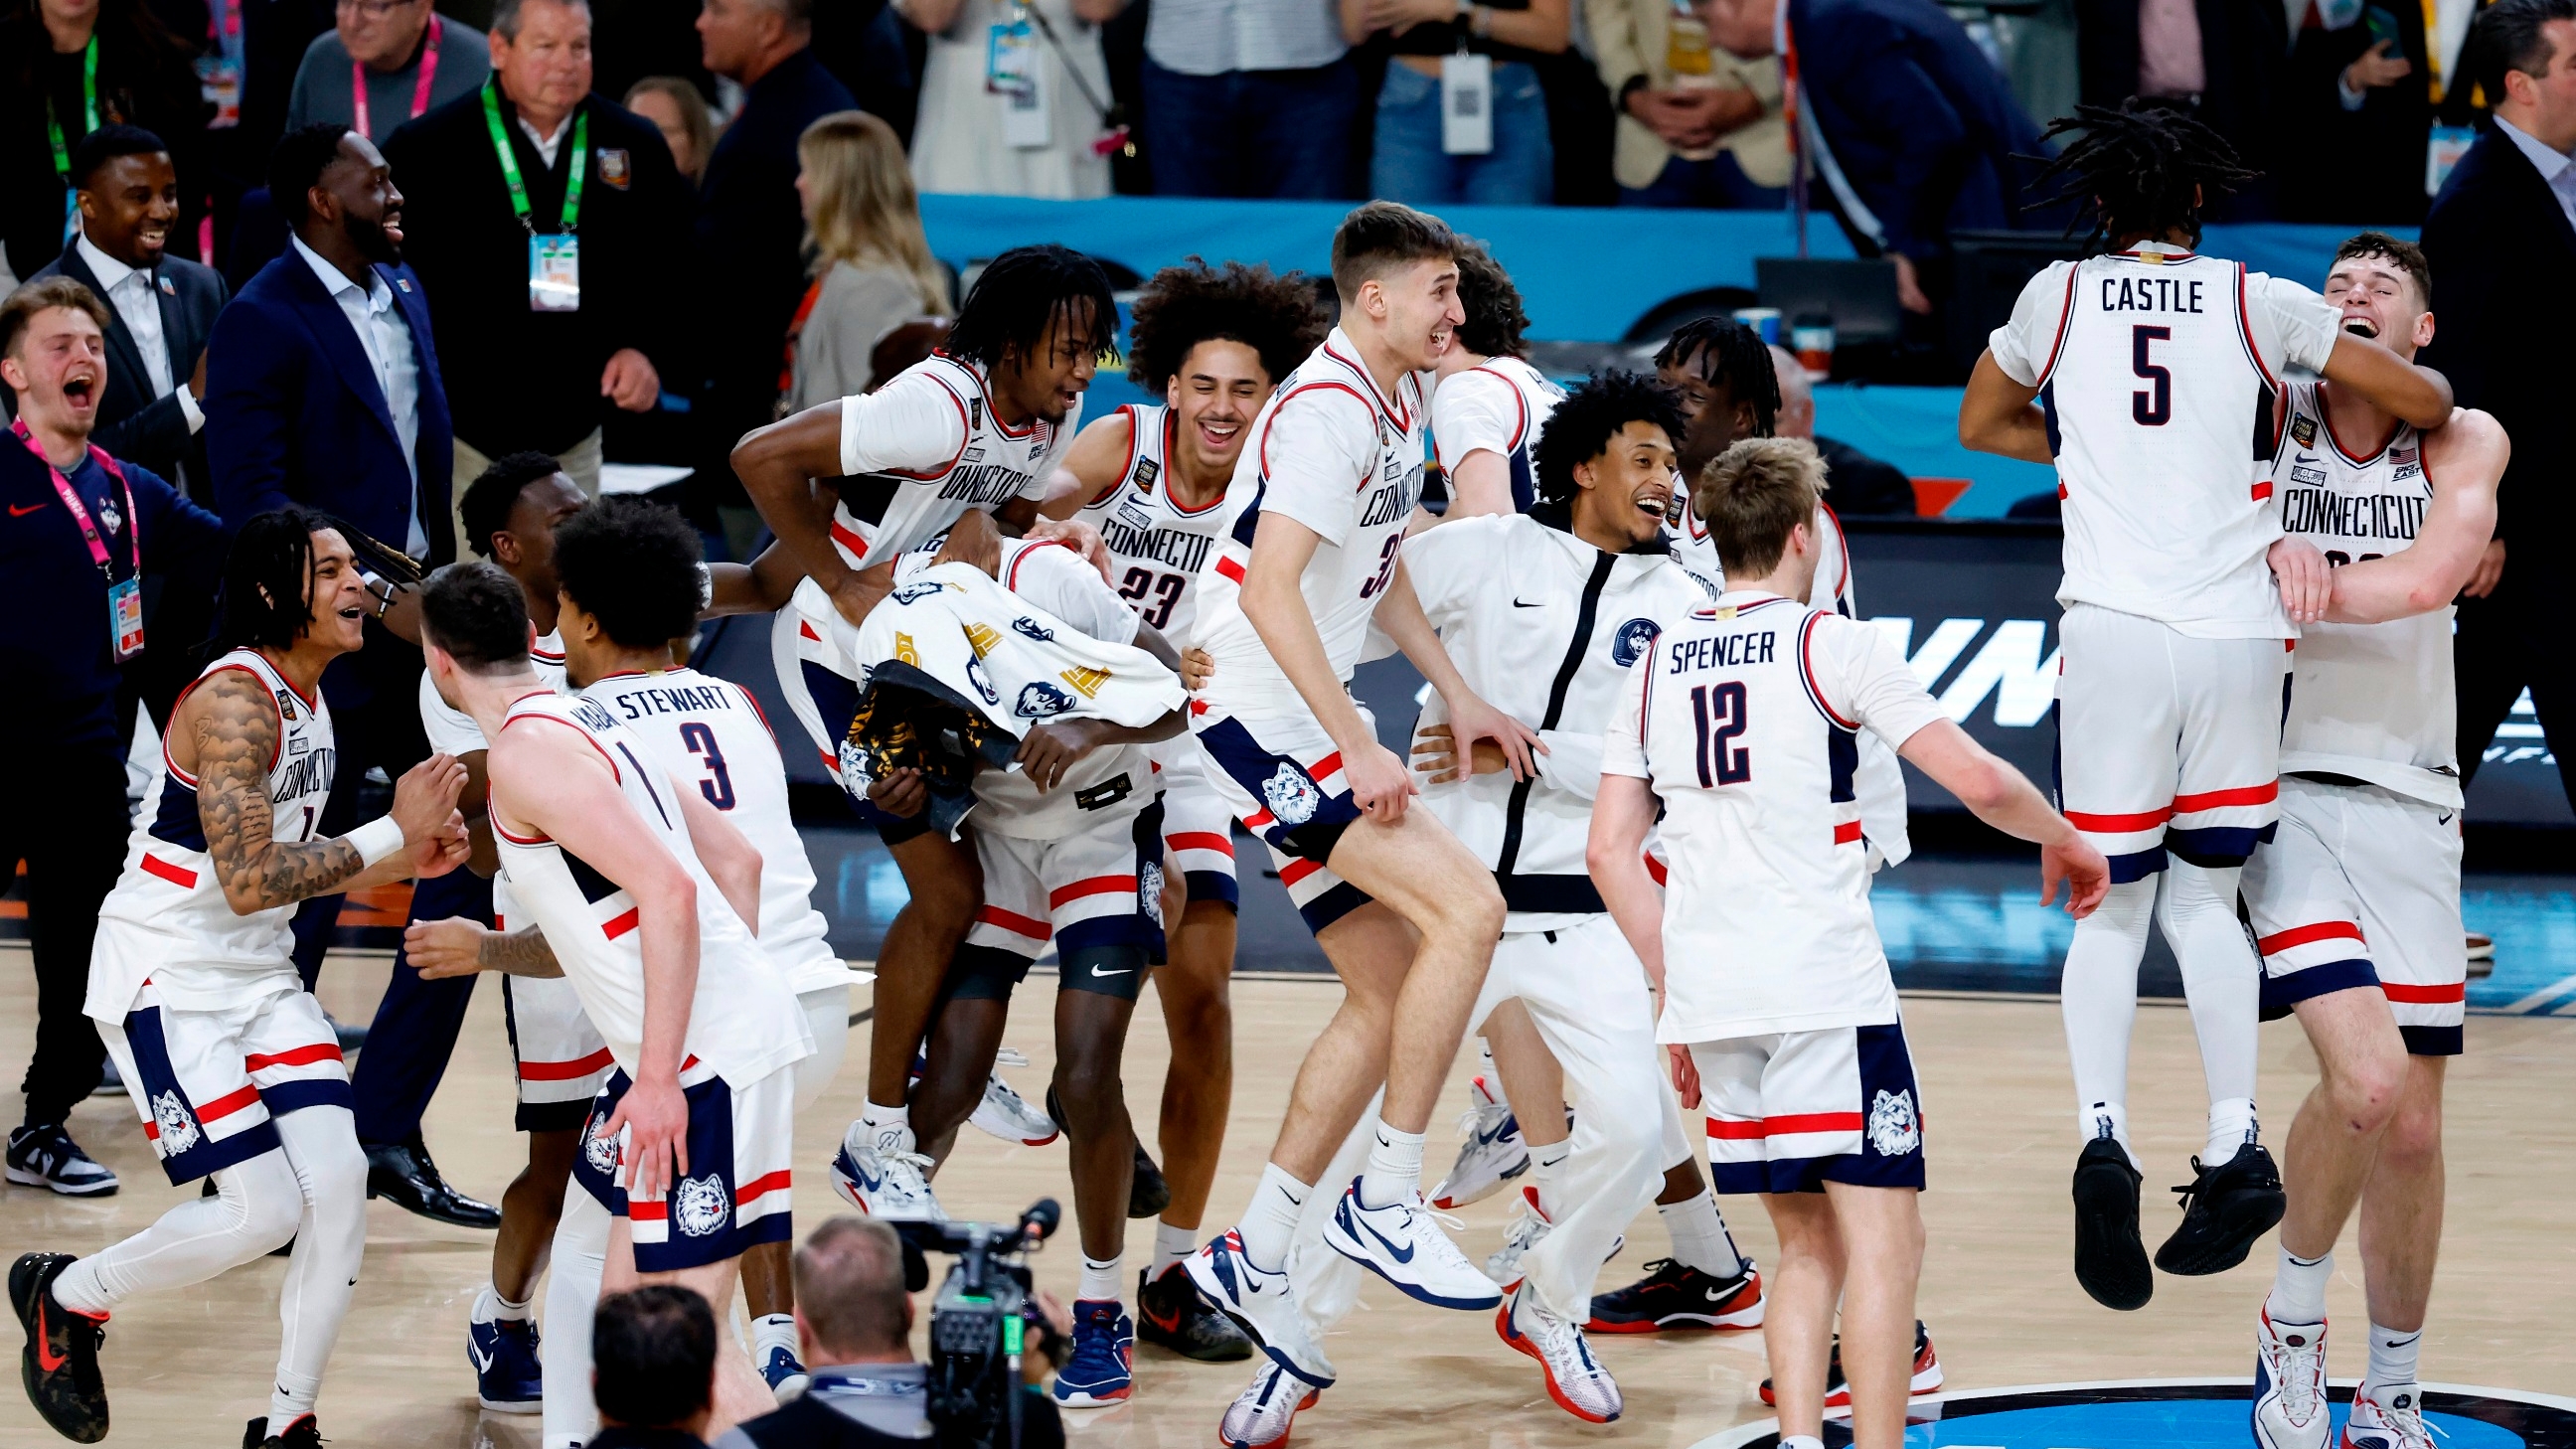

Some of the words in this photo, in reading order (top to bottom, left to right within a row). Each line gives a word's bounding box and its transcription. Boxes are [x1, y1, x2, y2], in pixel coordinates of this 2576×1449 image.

[2102, 277, 2203, 313] CASTLE
[2133, 324, 2172, 426] 5
[2292, 474, 2324, 486] CHANGE
[2395, 463, 2417, 473] BIG
[61, 488, 86, 520] PHN24
[2282, 489, 2425, 540] CONNECTICUT
[1100, 517, 1214, 573] CONNECTIC
[1118, 566, 1186, 630] 23
[1670, 631, 1776, 675] SPENCER
[615, 686, 731, 720] STEWART
[1690, 681, 1751, 789] 12
[679, 722, 735, 811] 3
